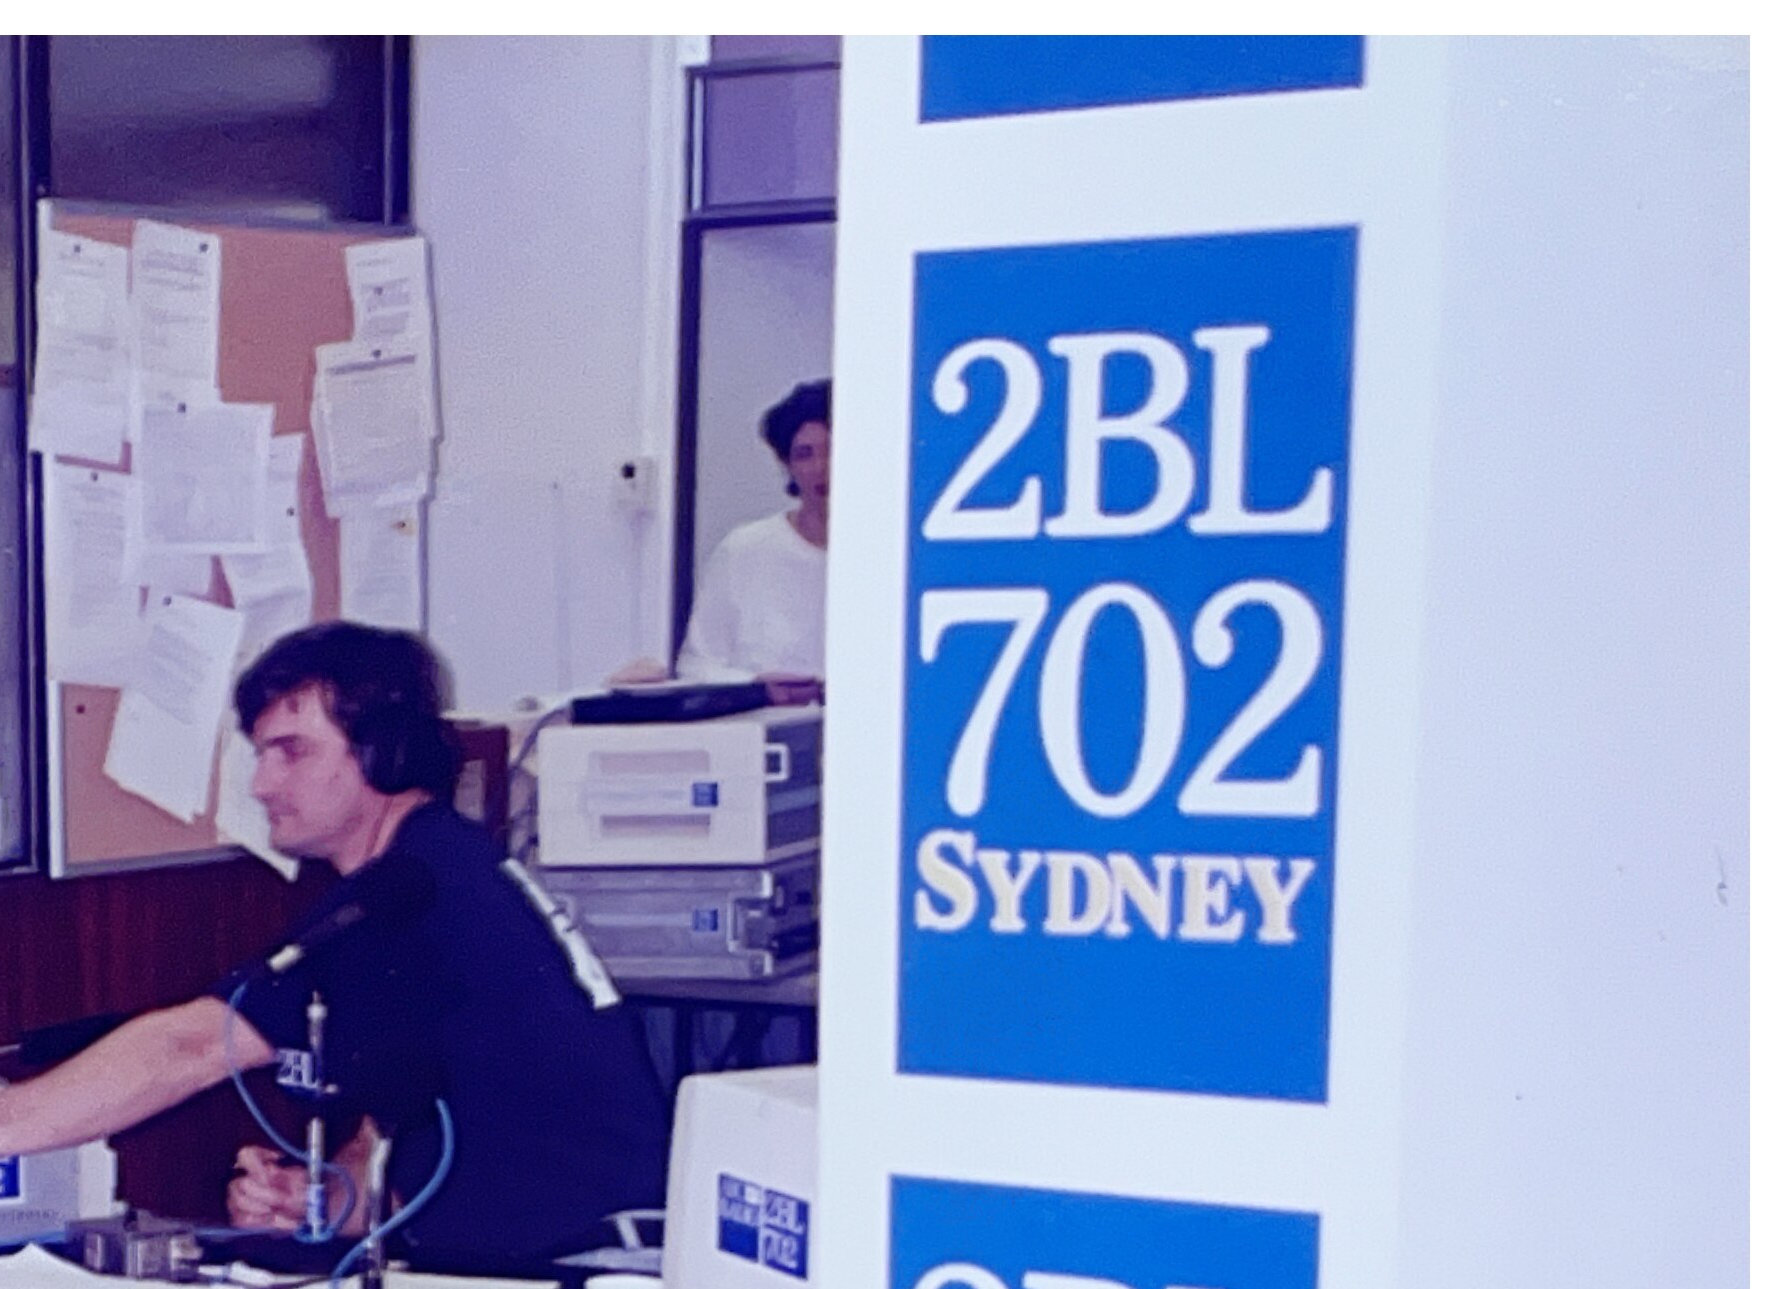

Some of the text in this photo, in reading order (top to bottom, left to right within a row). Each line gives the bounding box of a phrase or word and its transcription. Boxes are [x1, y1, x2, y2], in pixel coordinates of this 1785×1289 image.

[919, 323, 1336, 542] 2BL
[918, 577, 1325, 819] 702
[913, 827, 1317, 945] SYDNEY
